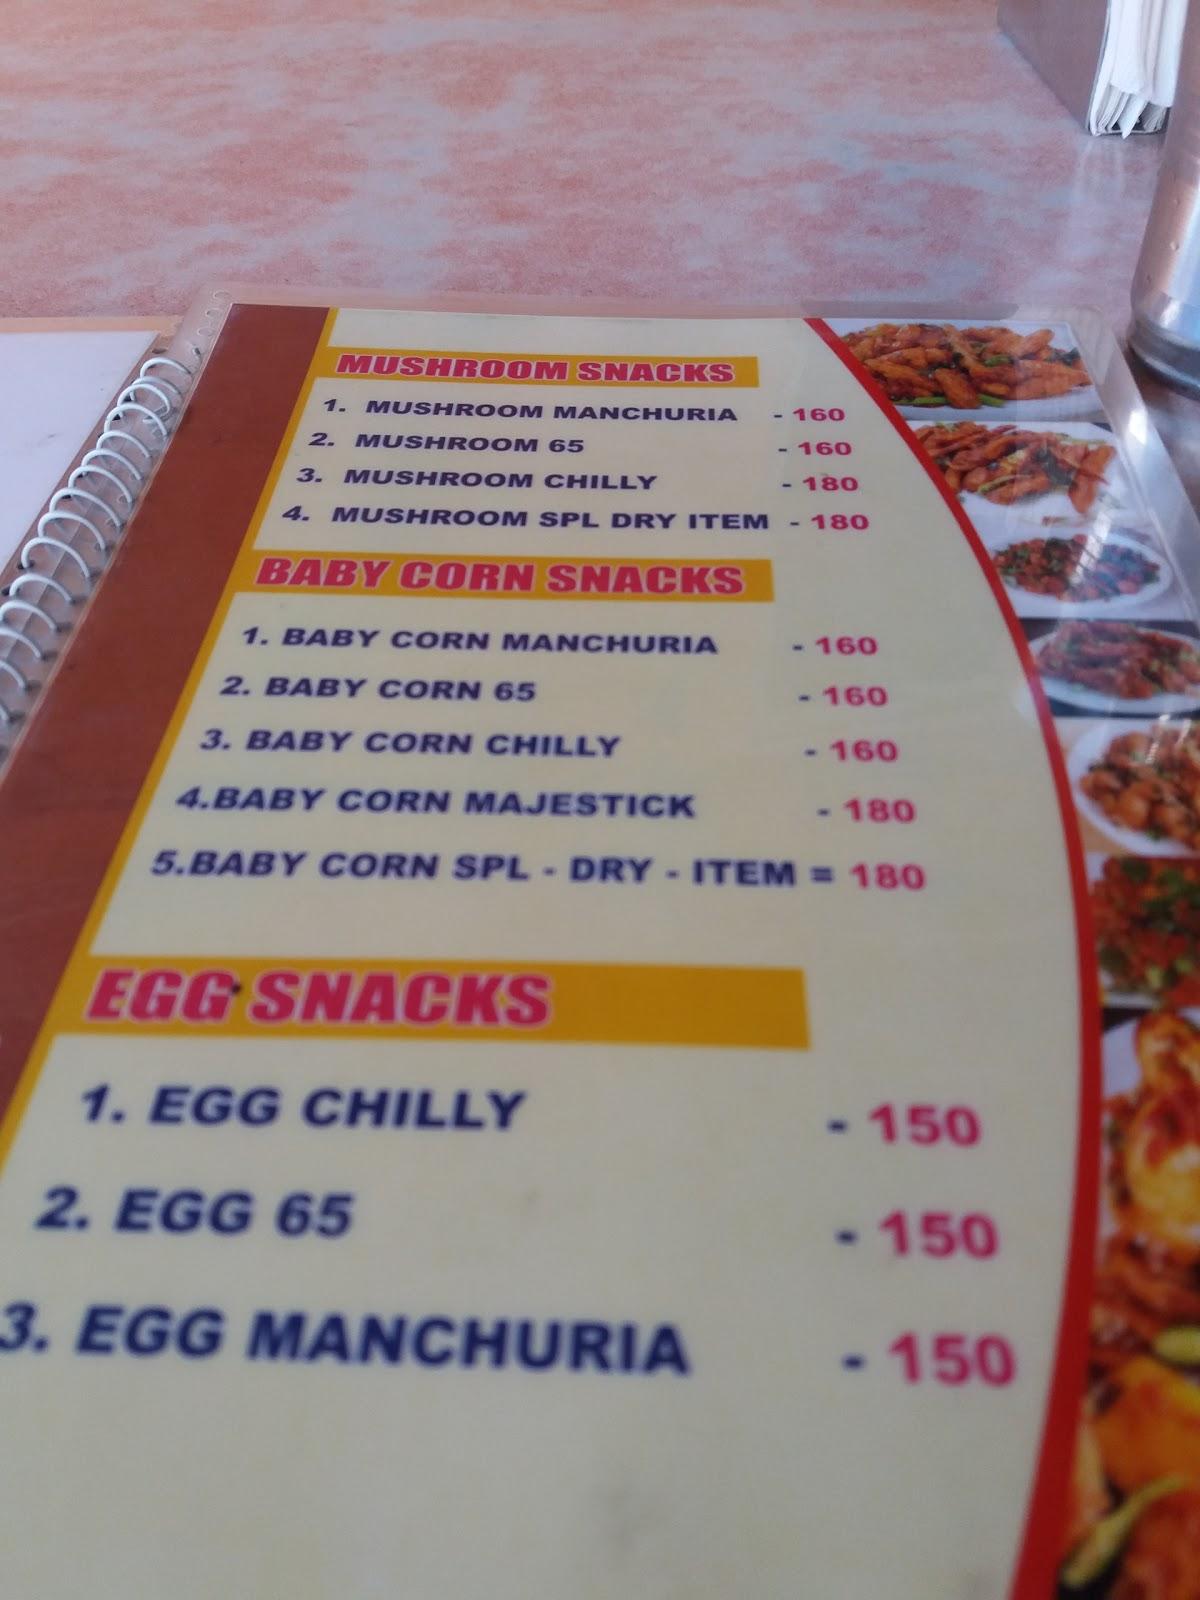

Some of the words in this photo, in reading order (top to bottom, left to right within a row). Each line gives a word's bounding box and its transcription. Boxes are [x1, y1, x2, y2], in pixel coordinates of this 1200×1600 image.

[338, 355, 567, 379] MUSHROOM
[579, 363, 732, 381] SNACKS
[324, 399, 345, 412] 1.
[366, 401, 543, 418] MUSHROOM
[554, 406, 737, 421] MANCHURIA
[793, 408, 845, 421] 160
[308, 433, 334, 446] 2.
[356, 434, 538, 452] MUSHROOM
[549, 440, 583, 452] 65
[799, 442, 851, 455] 160
[297, 468, 322, 482] 3.
[344, 470, 533, 488] MUSHROOM
[545, 474, 657, 489] CHILLY
[803, 476, 858, 491] 180
[282, 506, 309, 521] 4.
[332, 507, 527, 526] MUSHROOM
[539, 512, 599, 528] SPL
[612, 513, 676, 528] DRY
[689, 514, 768, 529] ITEM
[812, 515, 869, 530] 180
[257, 559, 389, 587] BABY
[401, 562, 533, 591] CORN
[548, 565, 742, 594] SNACKS
[244, 627, 267, 645] 1.
[282, 628, 379, 647] BABY
[391, 631, 489, 650] CORN
[502, 634, 717, 653] MANCHURIA
[816, 637, 877, 655] 160
[220, 676, 249, 695] 2.
[265, 677, 366, 697] BABY
[379, 680, 481, 700] CORN
[494, 682, 535, 701] 65
[825, 687, 887, 706] 160
[201, 729, 230, 750] 3.
[246, 730, 352, 751] BABY
[365, 732, 472, 754] CORN
[486, 735, 619, 756] CHILLY
[832, 740, 898, 762] 160
[177, 787, 325, 810] 4.BABY
[338, 790, 450, 812] CORN
[465, 792, 694, 817] MAJESTICK
[846, 799, 915, 822] 180
[152, 851, 306, 876] 5.BABY
[320, 853, 439, 878] CORN
[454, 855, 528, 880] SPL
[571, 857, 651, 882] DRY
[694, 860, 796, 886] ITEM
[852, 864, 925, 890] 180
[90, 971, 234, 1020] EGG
[252, 972, 548, 1025] SNACKS
[84, 1085, 124, 1122] 1.
[150, 1087, 279, 1126] EGG
[303, 1089, 524, 1129] CHILLY
[871, 1104, 980, 1146] 150
[36, 1187, 88, 1229] 2.
[116, 1189, 253, 1234] EGG
[277, 1193, 353, 1237] 65
[882, 1211, 998, 1259] 150
[0, 1303, 48, 1351] 3.
[77, 1306, 223, 1358] EGG
[248, 1312, 689, 1375] MANCHURIA
[892, 1334, 1016, 1387] 150
